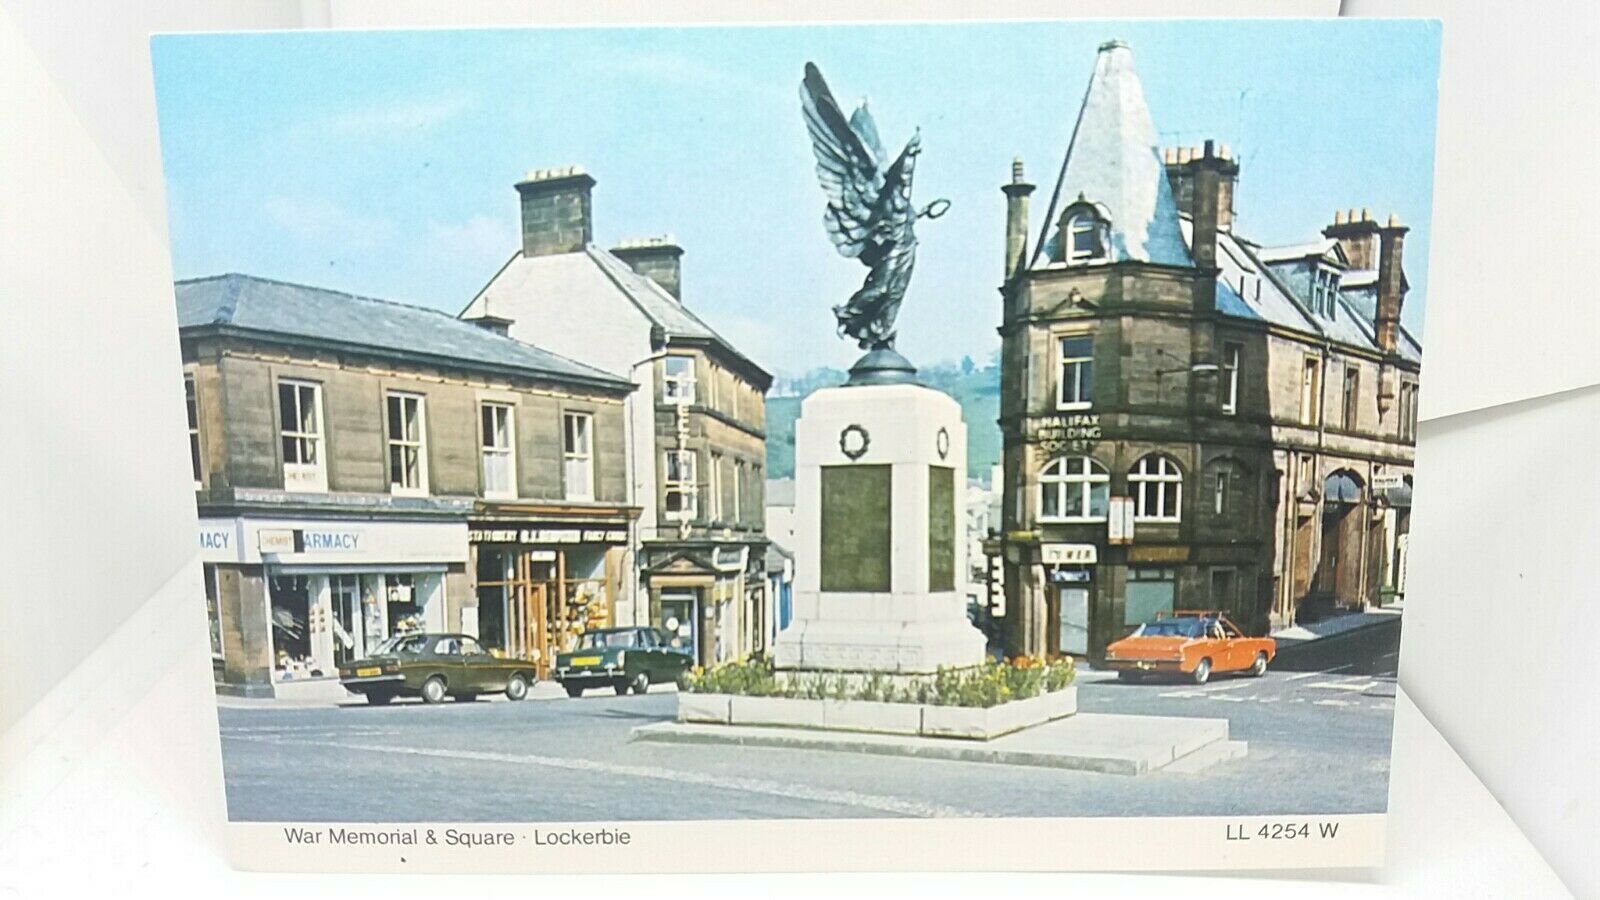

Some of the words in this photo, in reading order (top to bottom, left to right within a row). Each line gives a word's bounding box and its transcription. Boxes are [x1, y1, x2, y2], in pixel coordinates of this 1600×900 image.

[1040, 414, 1099, 428] HALIFAX
[1038, 427, 1102, 440] BUILDING
[284, 827, 322, 844] War
[329, 828, 417, 845] Memorial
[425, 829, 438, 845] &
[445, 829, 515, 848] Square
[534, 828, 631, 845] Lockerbie
[1226, 824, 1250, 840] LL
[1257, 822, 1310, 840] 4254
[1318, 822, 1339, 839] W
